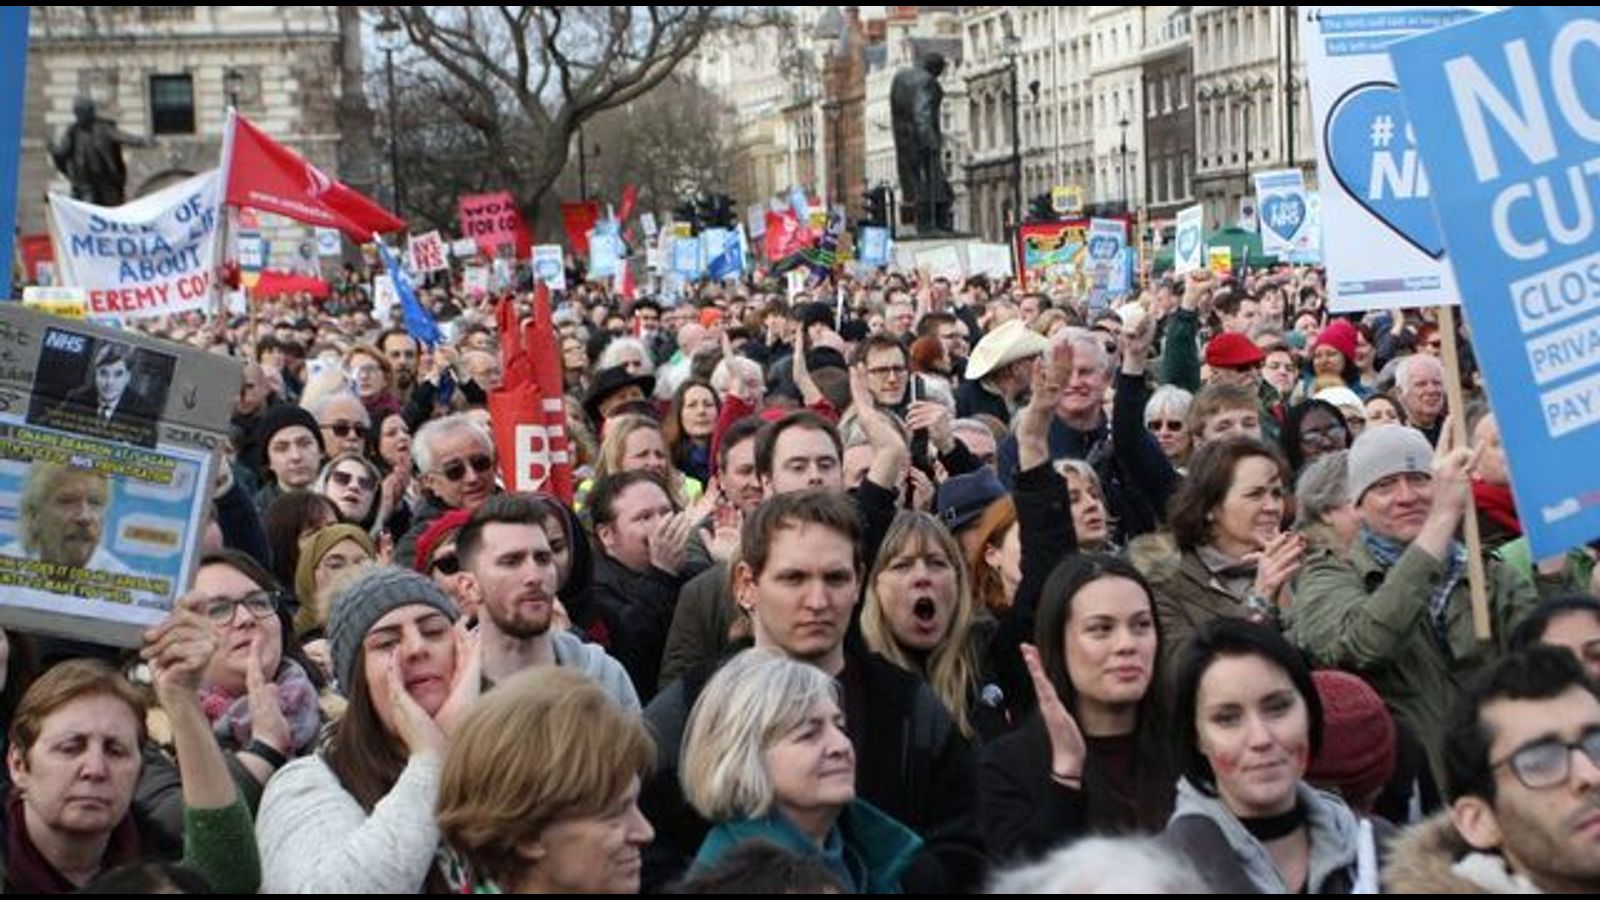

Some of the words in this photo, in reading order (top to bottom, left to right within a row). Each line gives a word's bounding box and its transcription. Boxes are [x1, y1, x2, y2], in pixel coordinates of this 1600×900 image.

[175, 193, 202, 222] OF
[71, 234, 171, 257] MEDIA
[120, 243, 200, 284] ABOUT
[89, 284, 170, 313] EREMY
[45, 331, 85, 352] NHS
[1548, 389, 1593, 427] PAY
